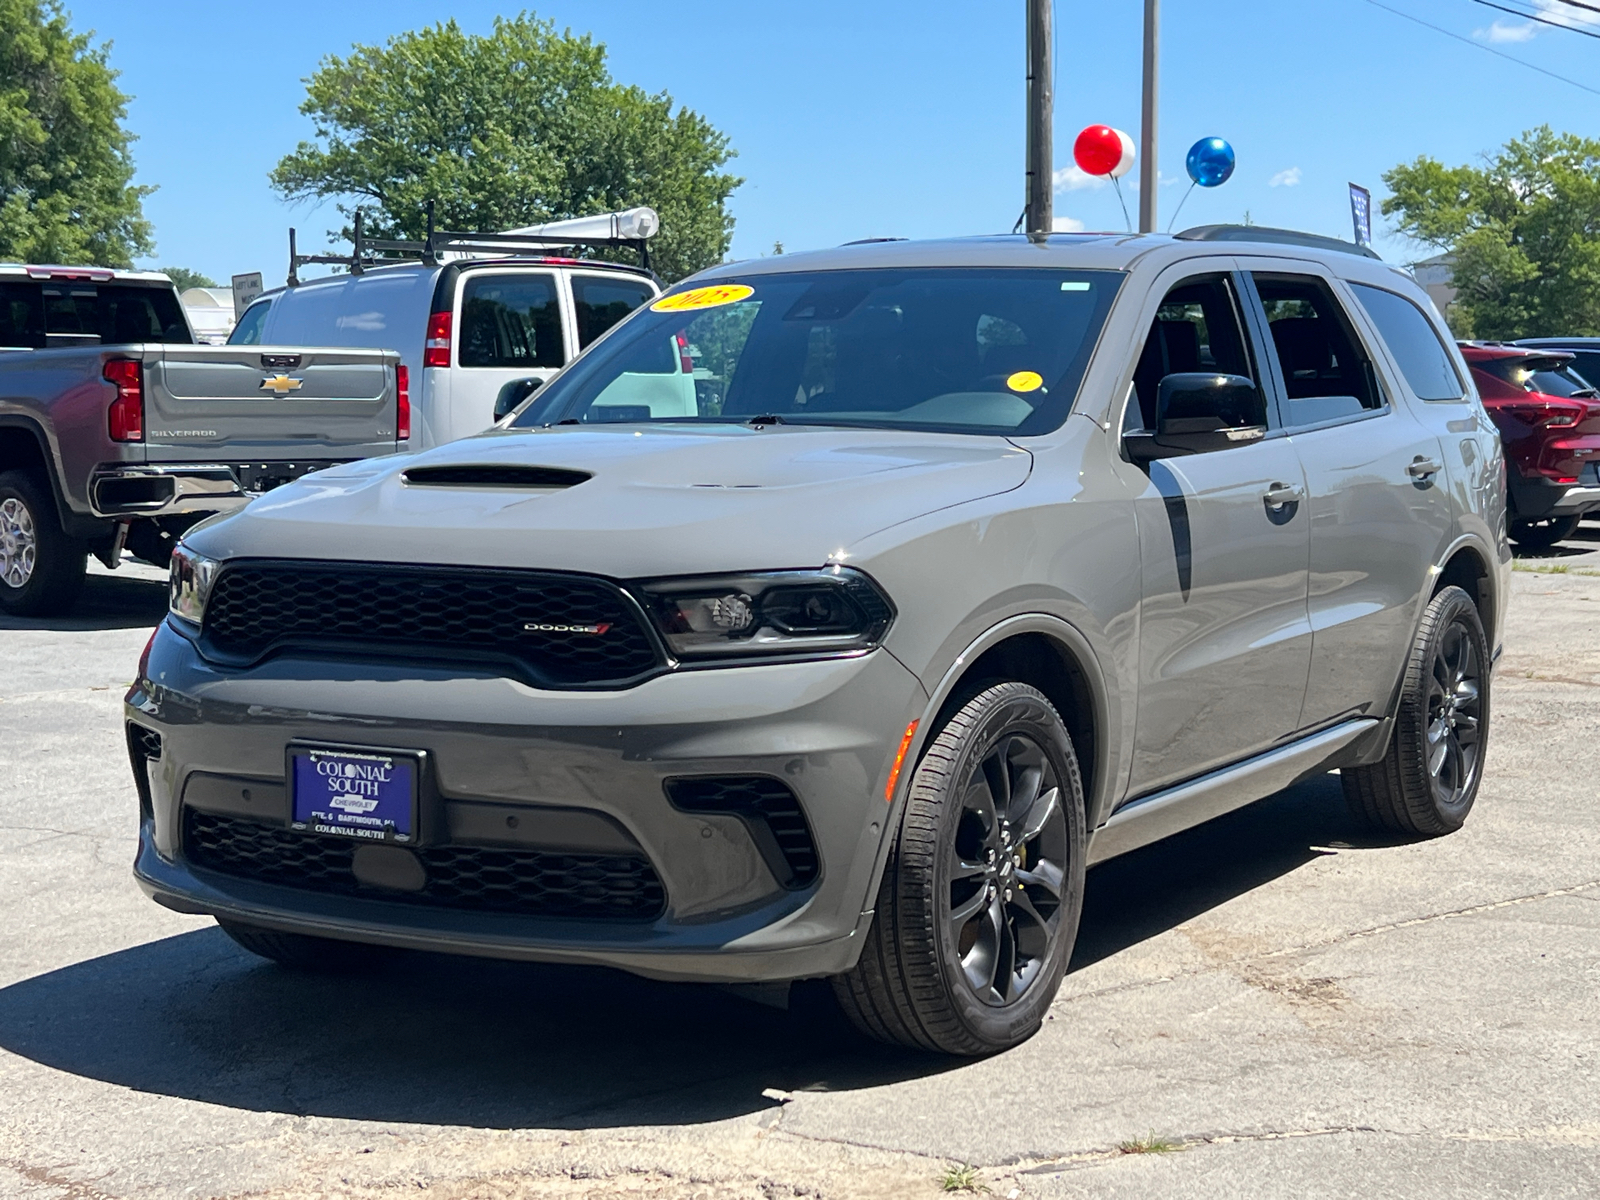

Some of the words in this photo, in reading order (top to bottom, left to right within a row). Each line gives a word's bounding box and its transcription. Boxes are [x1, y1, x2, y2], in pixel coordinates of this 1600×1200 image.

[524, 623, 598, 633] DODGE
[317, 761, 391, 782] COLONIAL
[328, 777, 379, 796] SOUTH
[334, 798, 374, 809] CHEVROLET
[314, 824, 356, 836] COLONIAL
[356, 829, 385, 840] SOUTH
